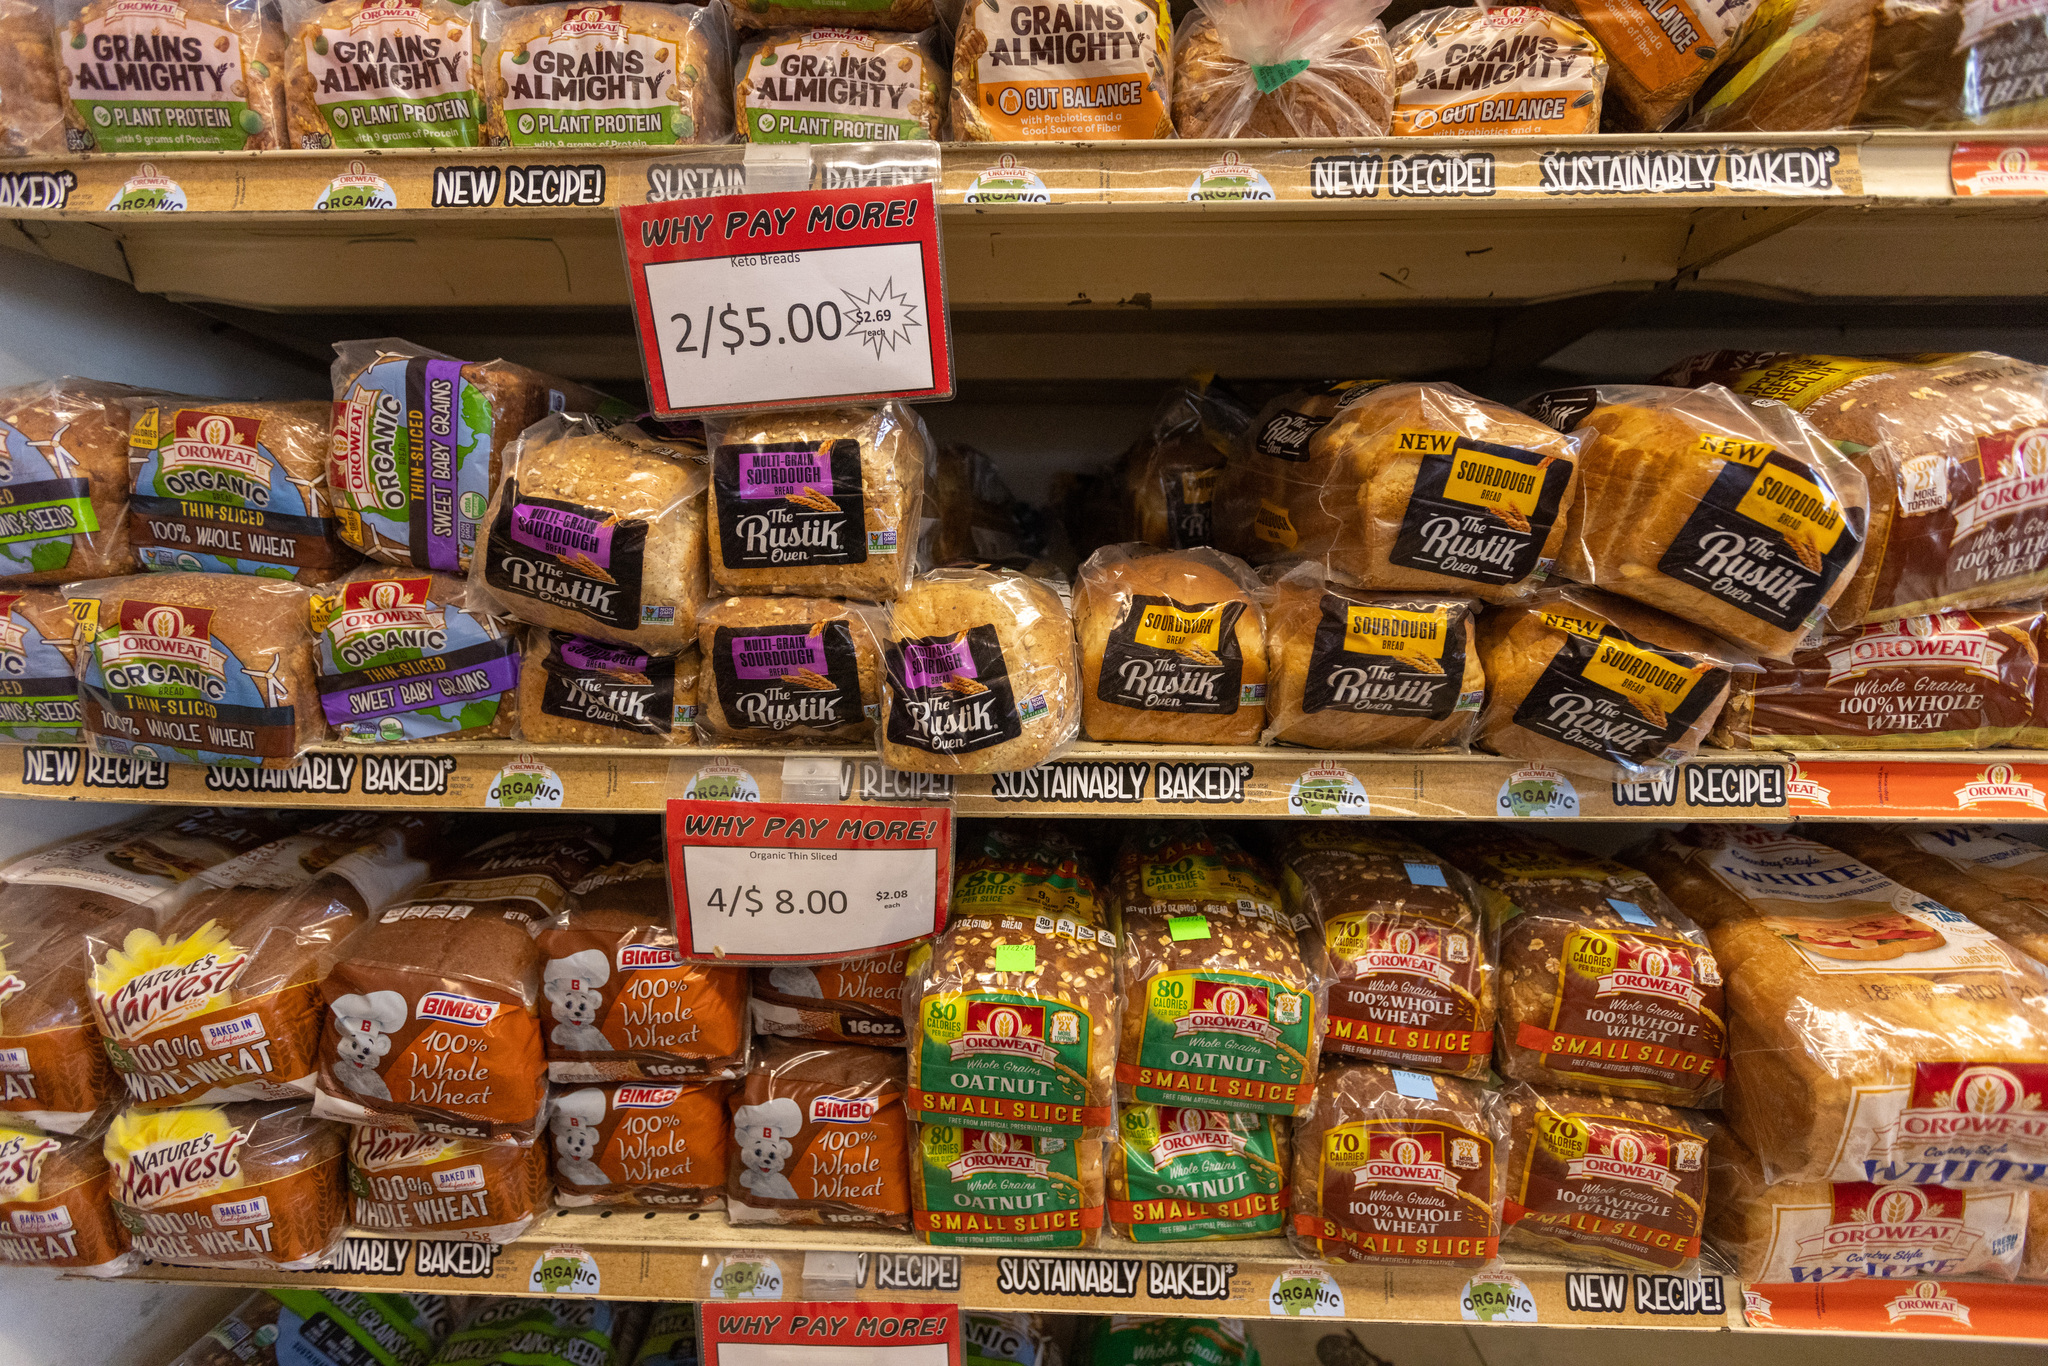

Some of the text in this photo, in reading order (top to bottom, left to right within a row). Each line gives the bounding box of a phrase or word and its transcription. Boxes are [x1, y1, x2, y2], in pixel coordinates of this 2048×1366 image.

[1010, 4, 1124, 37] GRAINS
[93, 34, 202, 63] GRAINS
[989, 30, 1143, 66] ALMIGHTY
[533, 50, 644, 75] GRAINS
[76, 62, 226, 92] ALMIGHTY
[511, 71, 661, 102] ALMIGHTY
[1025, 81, 1141, 109] GUT BALANCE
[115, 106, 232, 128] PLANT PROTEIN
[539, 113, 661, 134] PLANT PROTEIN
[1021, 116, 1042, 126] with
[1044, 113, 1093, 125] Prebiotics
[1095, 112, 1112, 123] and
[1022, 122, 1121, 136] Good Source of Fiber
[1314, 157, 1492, 196] NEW RECIPE!
[1543, 154, 1715, 192] SUSTAINABLY
[436, 170, 602, 206] NEW RECIPE!
[642, 199, 918, 246] WHY PAY MORE!
[730, 253, 800, 268] Keto Breads
[856, 310, 891, 325] $2.69
[670, 301, 842, 359] 2/$5.00
[867, 328, 886, 338] each
[1399, 433, 1452, 452] NEW
[1700, 436, 1765, 463] NEW
[177, 445, 252, 467] OROWEAT
[409, 409, 424, 501] THIN-SLICED
[431, 379, 453, 538] SWEET BABY GRAINS
[752, 454, 814, 468] MULTI-GRAIN
[747, 467, 821, 485] SOURDOUGH
[1457, 460, 1537, 495] SOURDOUGH
[165, 470, 270, 508] ORGANIC
[774, 486, 794, 496] BREAD
[181, 501, 265, 527] THIN-SLICED
[1757, 477, 1840, 530] SOURDOUGH
[767, 508, 793, 524] The
[1462, 516, 1487, 534] The
[149, 521, 296, 559] 100% WHOLE WHEAT
[736, 515, 847, 553] Rustik
[1420, 517, 1531, 572] Rustik
[771, 549, 809, 563] Oven
[1748, 537, 1775, 561] The
[1440, 556, 1479, 575] Oven
[1698, 531, 1816, 611] Rustik
[72, 601, 92, 620] 70
[346, 611, 424, 627] OROWEAT
[123, 637, 204, 660] OROWEAT
[342, 630, 448, 666] ORGANIC
[1854, 640, 1976, 660] OROWEAT
[364, 656, 446, 683] THIN-SLICED
[1154, 658, 1176, 673] The
[1600, 645, 1688, 695] SOURDOUGH
[106, 662, 226, 700] ORGANIC
[1119, 658, 1225, 700] Rustik
[1854, 676, 1976, 696] Whole Grains
[158, 686, 185, 696] BREAD
[349, 670, 490, 715] SWEET BABY GRAINS
[127, 694, 218, 718] THIN-SLICED
[1838, 694, 1984, 714] 100% WHOLE
[102, 710, 255, 750] 100% WHOLE WHEAT
[1866, 712, 1949, 730] WHEAT
[26, 750, 166, 786] NEW RECIPE!
[490, 780, 560, 801] ORGANIC
[996, 766, 1147, 799] SUSTAINABLY
[1968, 787, 2028, 798] OROWEAT
[685, 815, 938, 841] WHY PAY MORE!
[750, 851, 838, 861] Organic Thin Sliced
[775, 889, 848, 914] 8.00
[876, 890, 908, 901] $2.08
[1579, 937, 1608, 954] 70
[1573, 952, 1612, 968] CALORIES
[1614, 975, 1686, 996] OROWEAT
[422, 998, 492, 1021] BIMBO
[929, 1001, 957, 1021] 80
[1609, 999, 1685, 1021] Whole Grains
[927, 1018, 961, 1033] CALORIES
[1585, 1008, 1699, 1037] 100% WHOLE
[422, 1030, 488, 1052] 100%
[966, 1038, 1038, 1054] OROWEAT
[1606, 1025, 1672, 1044] WHEAT
[410, 1052, 489, 1082] Whole
[1552, 1036, 1715, 1075] SMALL SLICE
[967, 1059, 1042, 1076] Whole Grains
[408, 1079, 492, 1105] Wheat
[951, 1074, 1052, 1096] OATNUT
[813, 1100, 874, 1119] BIMBO
[923, 1094, 1083, 1123] SMALL SLICE
[949, 1117, 1053, 1133] FREE FROM ARTIFICIAL PRESERVATIVES
[818, 1130, 878, 1152] 100%
[132, 1132, 214, 1175] NATURE'S
[809, 1147, 880, 1176] Whole
[114, 1133, 246, 1202] Harvest
[810, 1174, 885, 1199] Wheat
[219, 1201, 260, 1216] BAKED IN
[146, 1210, 213, 1236] 100%
[200, 1222, 274, 1255] WHEAT
[1828, 1225, 1950, 1245] OROWEAT
[1992, 1233, 2018, 1248] FRESH
[1892, 1250, 1924, 1260] Style
[999, 1258, 1141, 1294] SUSTAINABLY
[1272, 1286, 1341, 1308] ORGANIC
[1569, 1274, 1721, 1311] NEW RECIPE!
[1897, 1300, 1954, 1312] OROWEAT
[718, 1316, 948, 1337] WHY PAY MORE!
